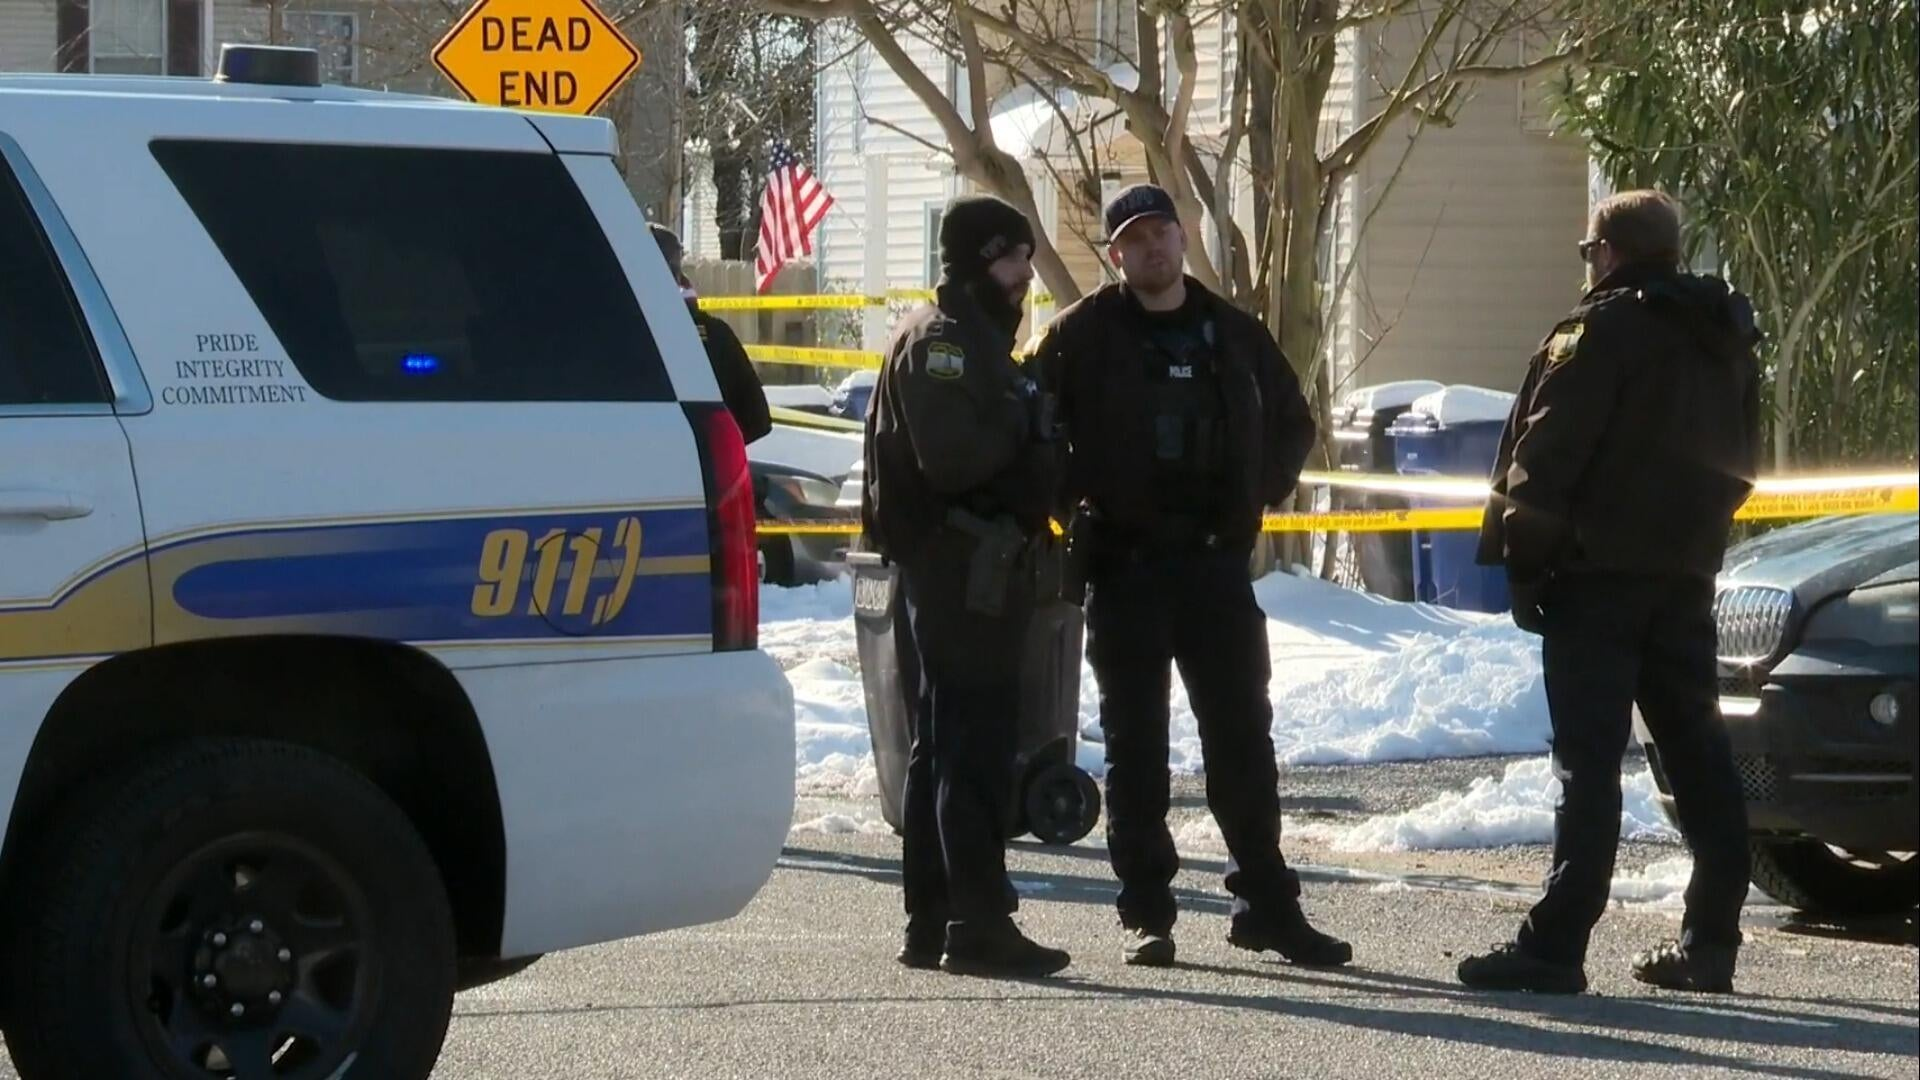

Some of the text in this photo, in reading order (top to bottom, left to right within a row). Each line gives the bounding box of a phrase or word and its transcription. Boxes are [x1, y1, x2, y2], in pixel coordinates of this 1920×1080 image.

[481, 16, 592, 52] DEAD
[499, 70, 578, 107] END
[195, 333, 259, 353] PRIDE
[175, 359, 284, 379] INTEGRITY
[1169, 365, 1193, 379] POLICE
[161, 384, 306, 405] COMMITMENT
[471, 527, 603, 617] 911
